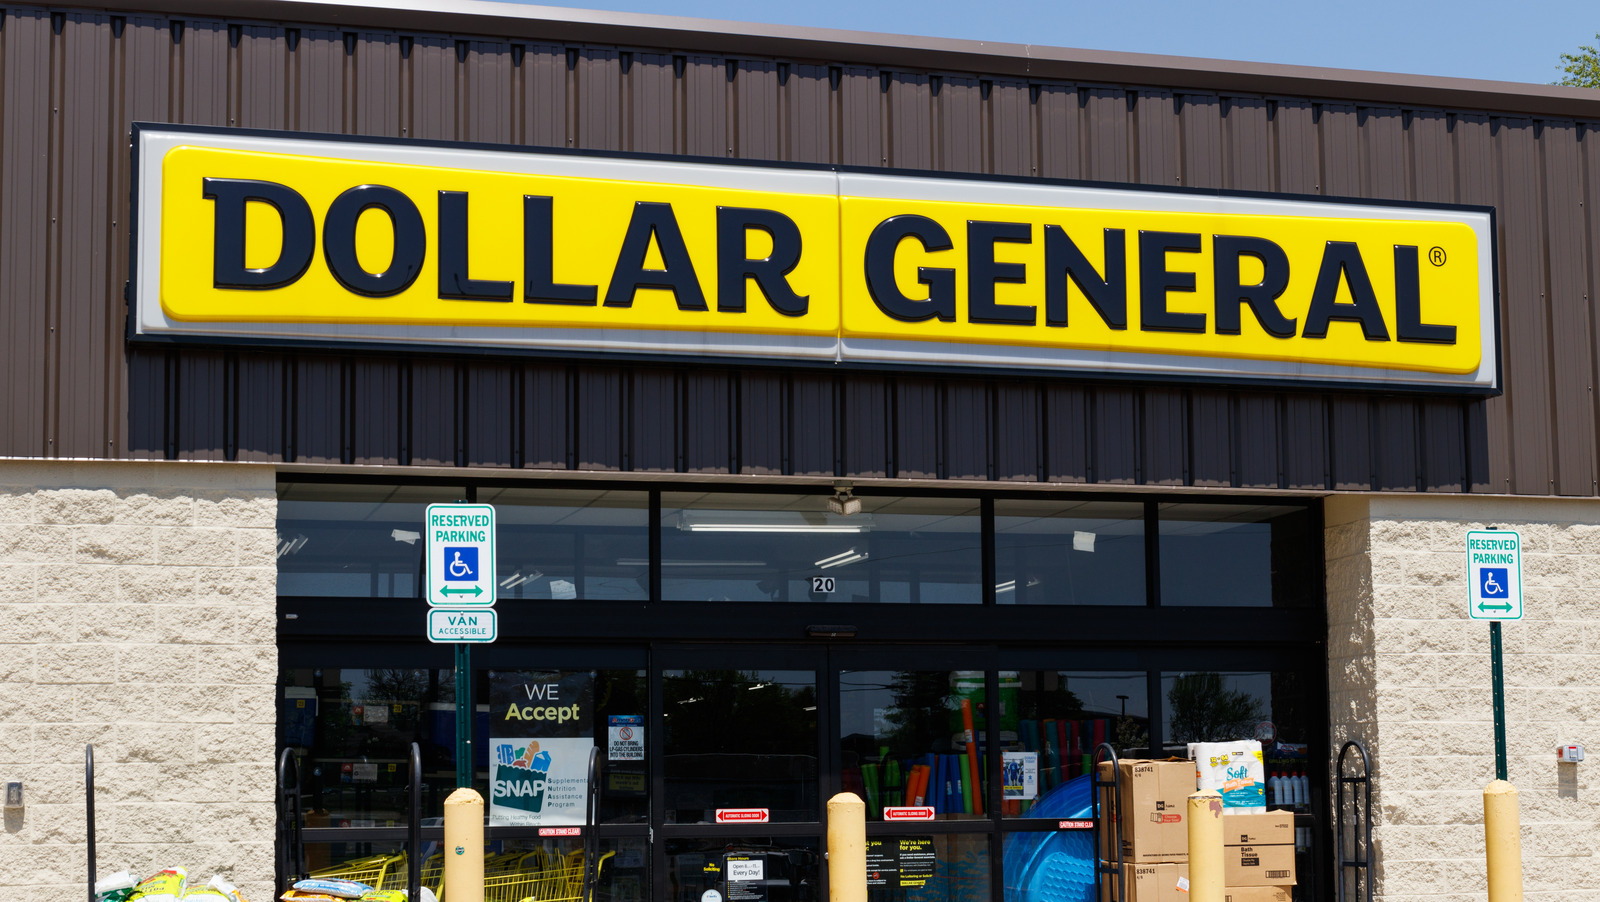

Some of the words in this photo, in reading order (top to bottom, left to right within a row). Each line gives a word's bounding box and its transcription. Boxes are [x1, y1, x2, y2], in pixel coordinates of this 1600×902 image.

[202, 177, 809, 318] DOLLAR
[864, 213, 1457, 345] GENERAL
[432, 515, 489, 526] RESERVED
[436, 530, 486, 542] PARKING
[1470, 539, 1516, 550] RESERVED
[1473, 553, 1513, 564] PARKING
[814, 578, 835, 592] 20
[448, 616, 478, 626] VAN
[525, 684, 559, 701] WE
[505, 703, 580, 724] Accept
[1226, 766, 1248, 780] Soft
[494, 779, 546, 797] SNAP
